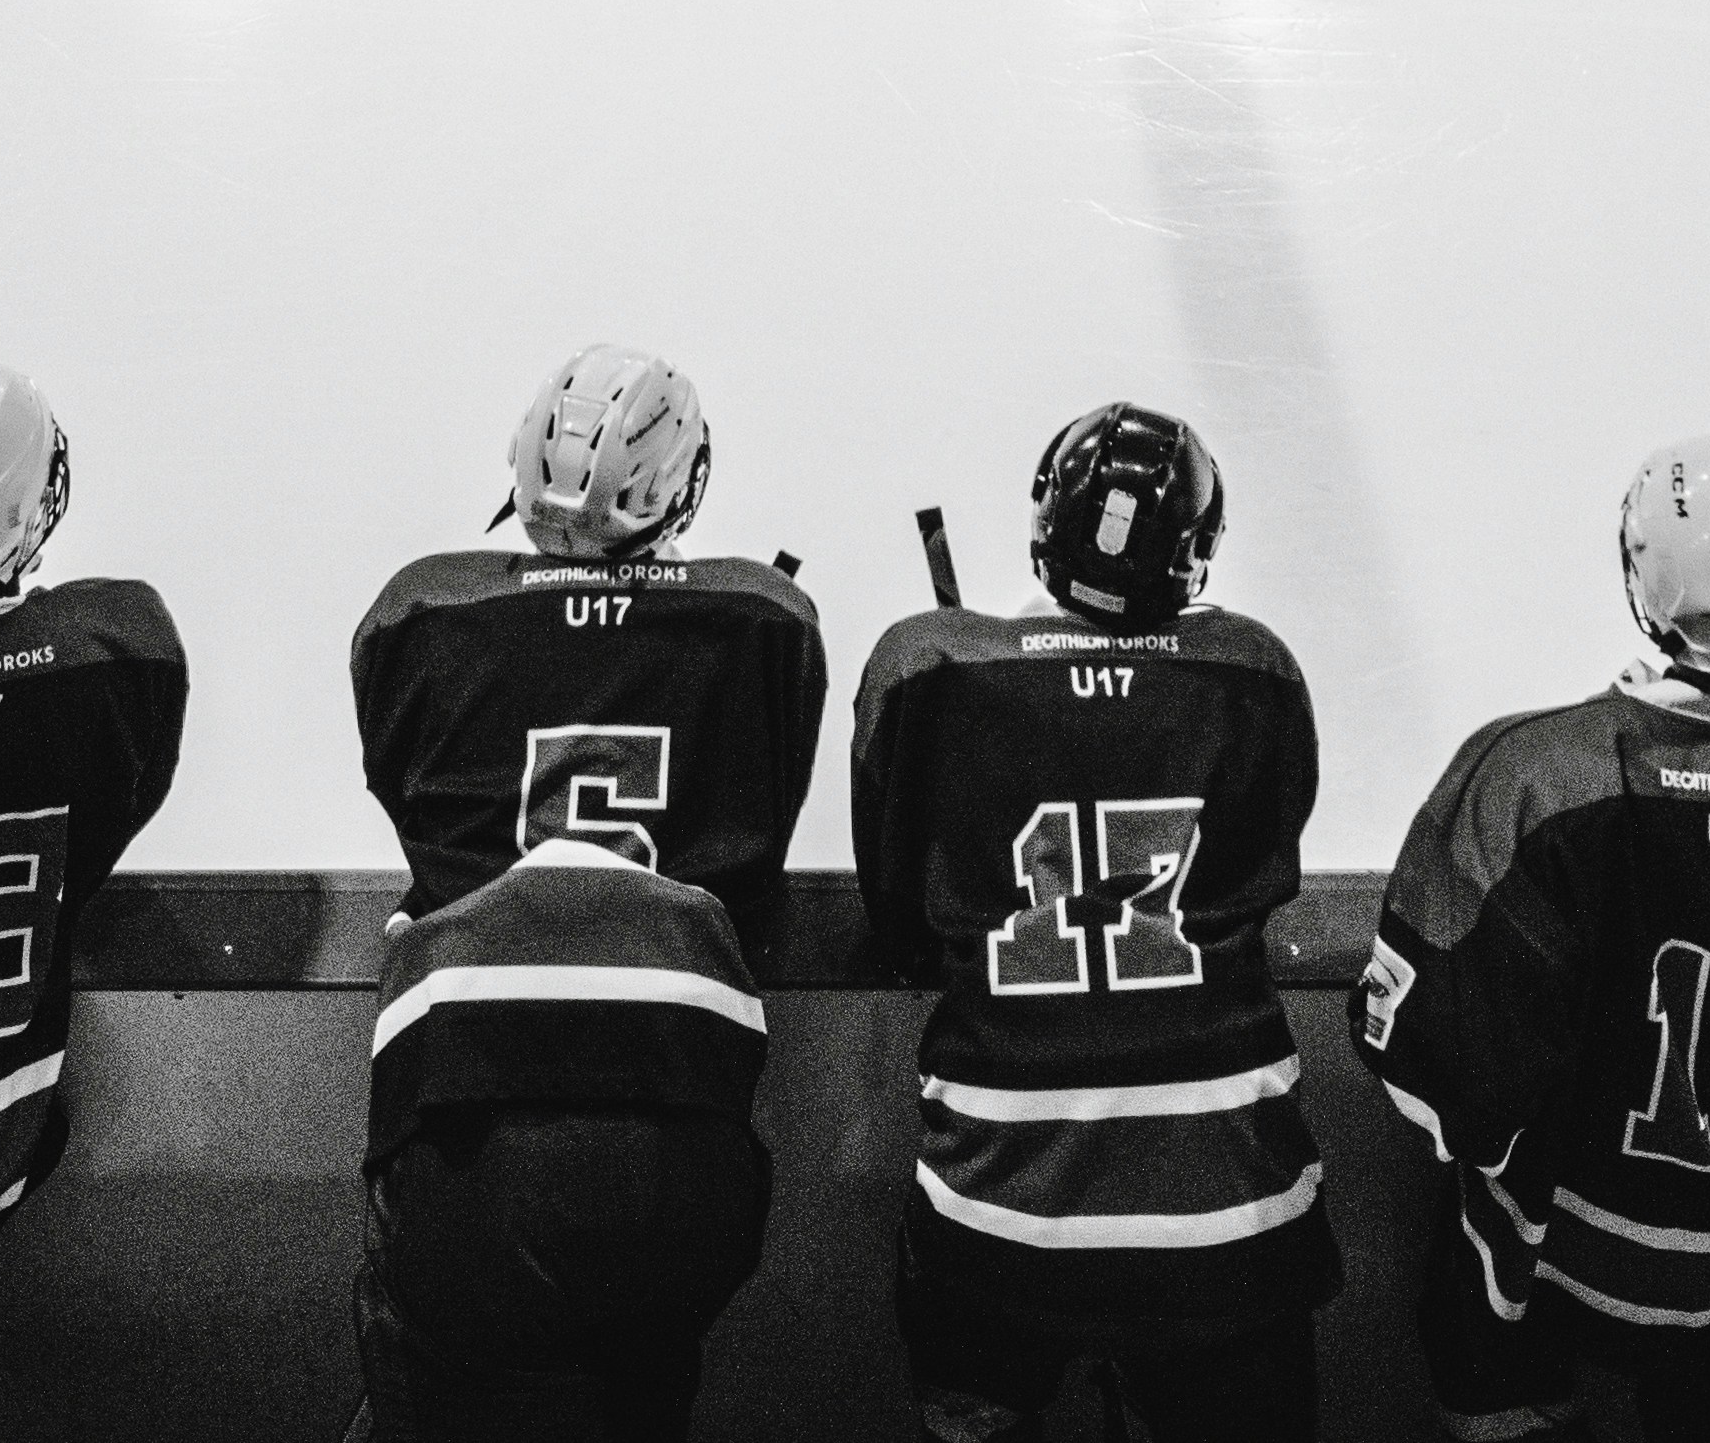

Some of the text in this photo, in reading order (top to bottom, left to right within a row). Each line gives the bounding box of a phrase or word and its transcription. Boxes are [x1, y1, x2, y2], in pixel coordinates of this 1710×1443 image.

[1671, 462, 1690, 519] CCM
[618, 563, 689, 584] OROKS
[566, 596, 634, 628] U17
[1070, 666, 1135, 698] U17
[988, 797, 1205, 995] 17
